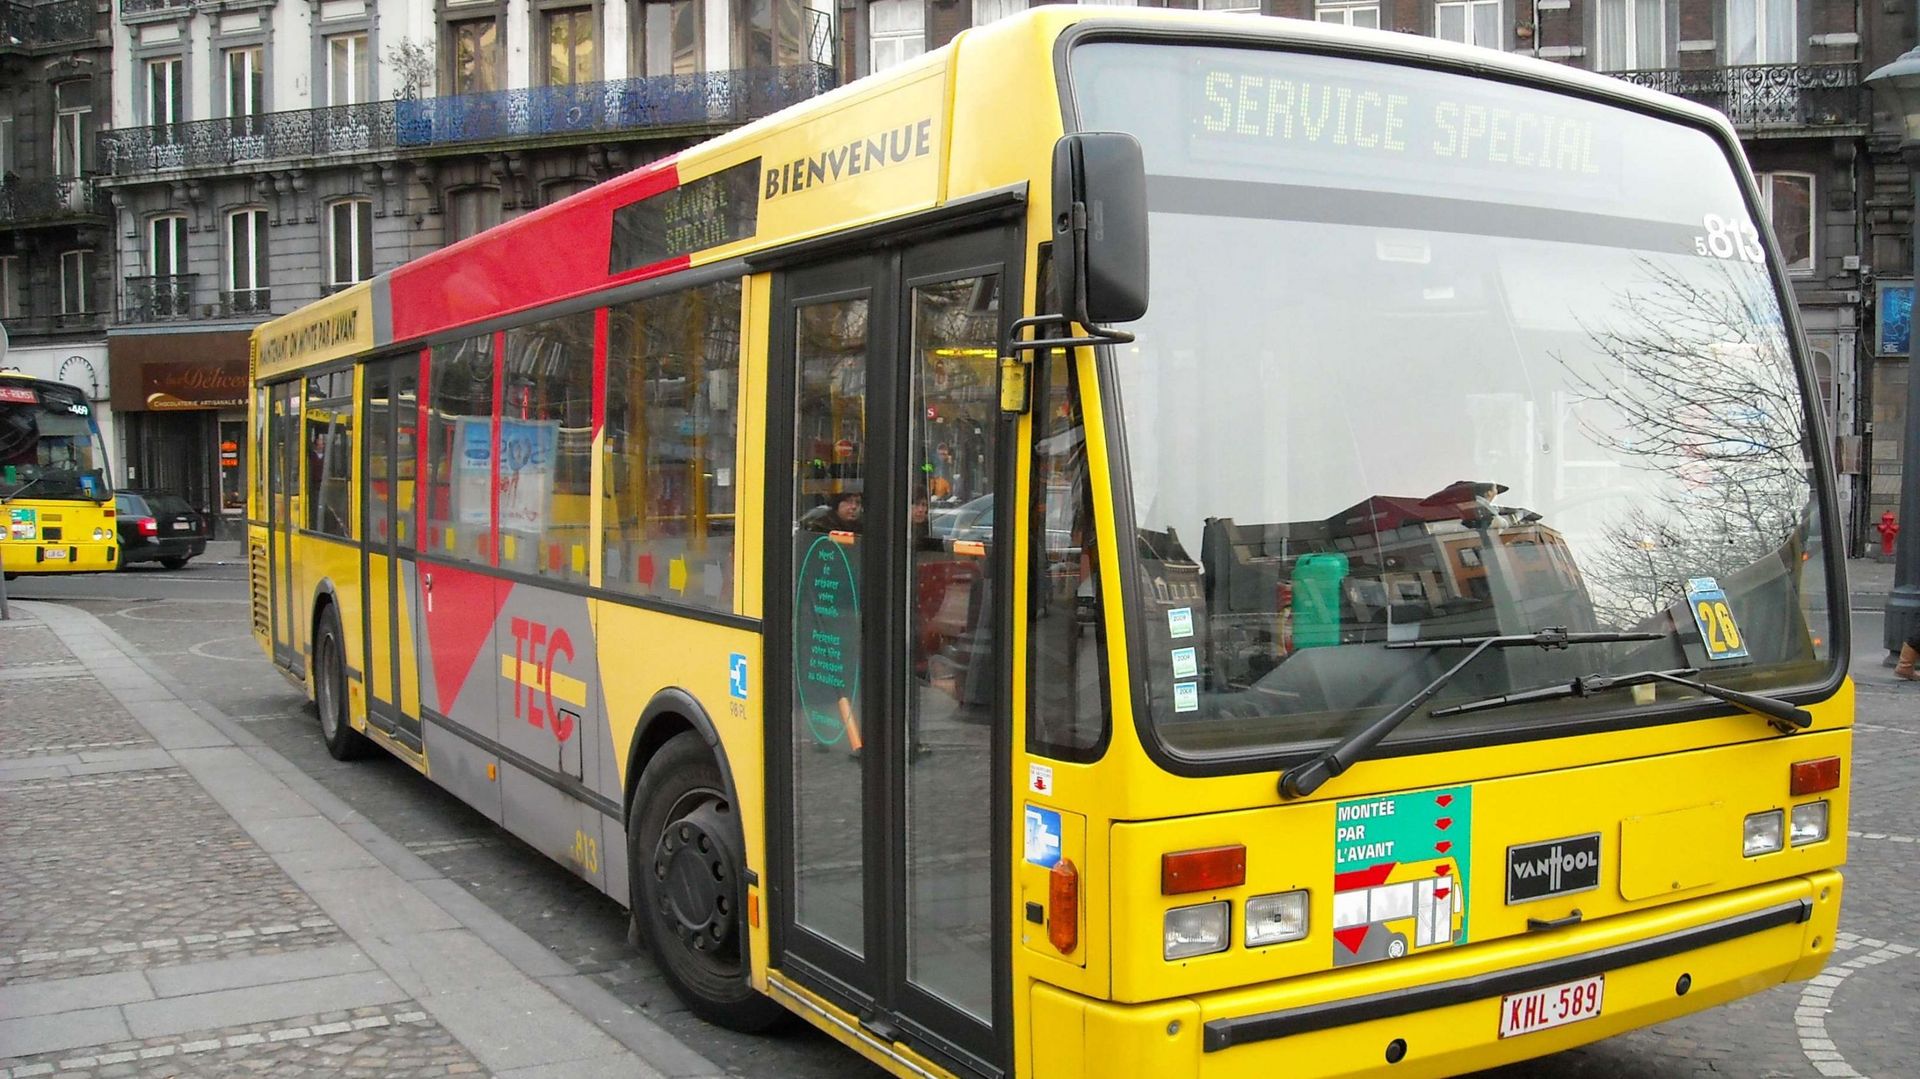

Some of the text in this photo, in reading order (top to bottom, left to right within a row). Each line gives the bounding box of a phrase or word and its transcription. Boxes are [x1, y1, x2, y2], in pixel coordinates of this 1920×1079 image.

[1203, 71, 1600, 174] SERVICE SPECIAL
[766, 119, 930, 199] BIENVENUE
[666, 213, 729, 254] SPECIAL
[319, 320, 330, 348] PAR
[331, 310, 357, 346] L'AVANT
[1698, 602, 1739, 653] 26
[511, 616, 575, 742] TEC
[1338, 798, 1395, 822] MONTÉE
[1337, 825, 1365, 842] PAR
[1337, 841, 1394, 863] L'AVANT
